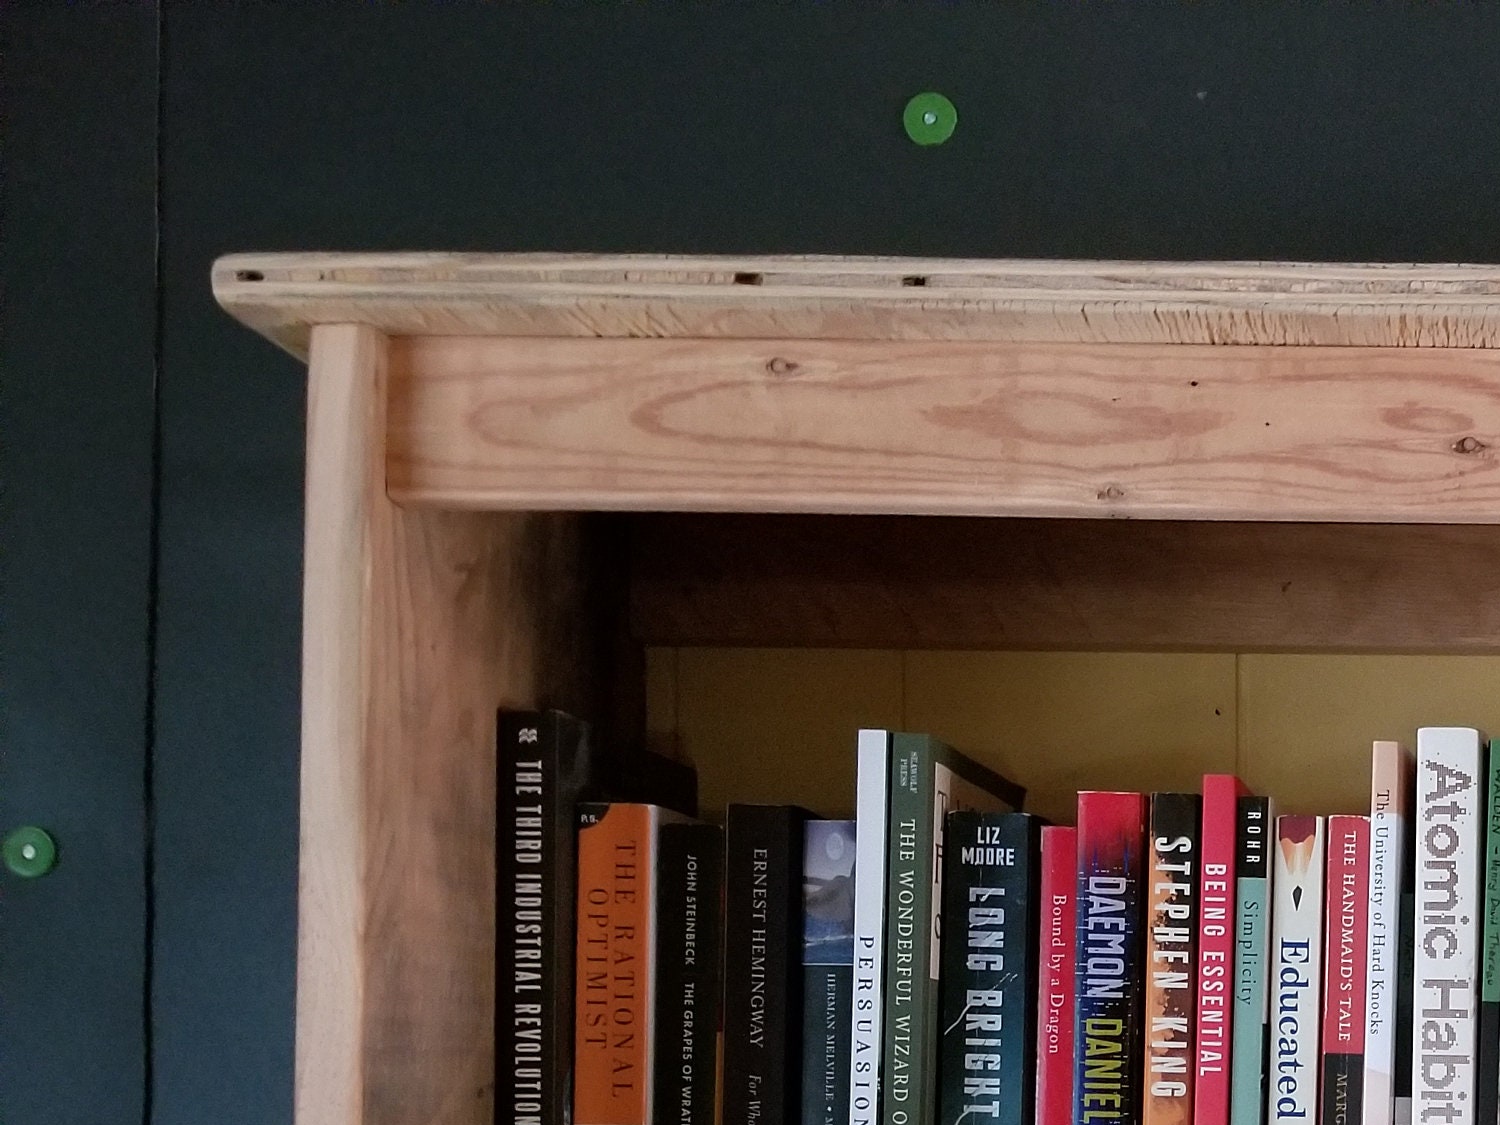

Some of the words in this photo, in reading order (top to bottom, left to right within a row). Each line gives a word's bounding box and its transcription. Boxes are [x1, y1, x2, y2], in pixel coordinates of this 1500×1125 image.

[515, 759, 543, 796] THE
[1375, 789, 1391, 820] The
[515, 804, 543, 864] THIRD
[898, 819, 916, 861] THE
[961, 847, 1015, 867] MOORE
[976, 826, 1002, 845] LIZ
[1245, 811, 1262, 863] ROHR
[1343, 830, 1357, 866] THE
[1370, 827, 1389, 907] University
[1423, 760, 1474, 960] Atomic
[614, 839, 637, 905] THE
[685, 853, 699, 892] JOHN
[751, 848, 769, 923] ERNEST
[1203, 863, 1227, 937] BEING
[513, 872, 543, 994] INDUSTRIAL
[683, 895, 698, 966] STEINBECK
[895, 869, 915, 1006] WONDERFUL
[966, 886, 1006, 971] LONG
[1051, 894, 1068, 947] Bound
[1085, 876, 1128, 998] DAEMON
[1153, 835, 1192, 989] STEPHEN
[1339, 873, 1356, 992] HANDMAID'S
[1373, 911, 1386, 930] of
[585, 888, 609, 1051] OPTIMIST
[1047, 953, 1066, 973] by
[1050, 977, 1060, 987] a
[1237, 900, 1259, 1006] Simplicity
[1371, 935, 1386, 973] Hard
[611, 924, 636, 1099] RATIONAL
[682, 982, 696, 1006] THE
[749, 928, 768, 1049] HEMINGWAY
[825, 972, 837, 1031] HERMAN
[1199, 950, 1225, 1077] ESSENTIAL
[1337, 997, 1352, 1041] TALE
[1369, 979, 1384, 1036] Knocks
[680, 1009, 695, 1061] GRAPES
[962, 989, 1004, 1118] BRIGHT
[1046, 992, 1065, 1054] Dragon
[1276, 937, 1311, 1120] Educated
[680, 1064, 693, 1082] OF
[746, 1074, 763, 1096] For
[822, 1034, 836, 1101] MELVILLE
[892, 1014, 911, 1103] WIZARD
[1082, 1017, 1124, 1124] DANIEL
[1150, 1016, 1189, 1098] KING
